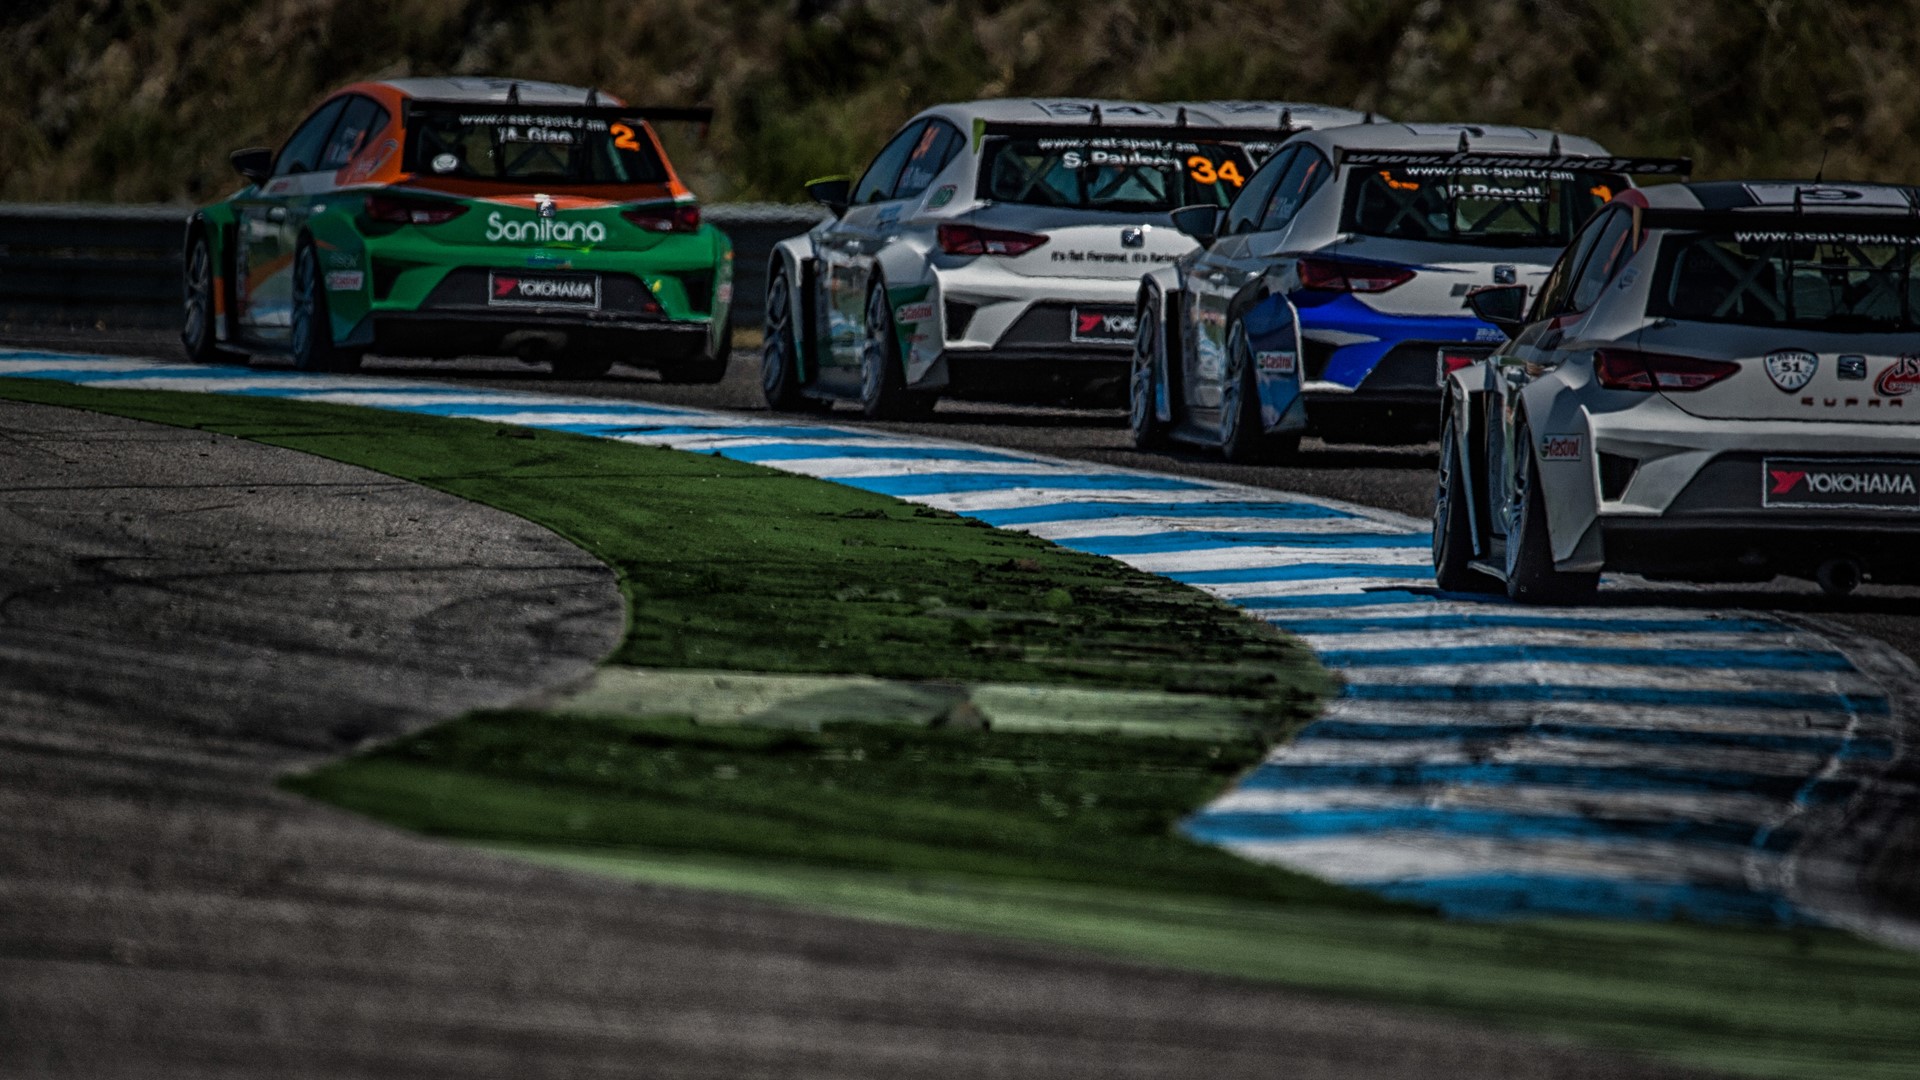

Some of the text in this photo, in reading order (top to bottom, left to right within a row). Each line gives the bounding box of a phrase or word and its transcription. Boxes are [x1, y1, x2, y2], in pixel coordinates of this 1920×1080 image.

[609, 121, 641, 152] 2
[1187, 154, 1246, 188] 34
[485, 210, 607, 242] Sanitana
[518, 280, 594, 298] YOKOHAMA
[1781, 361, 1802, 373] 51
[1805, 471, 1917, 494] YOKOHAMA
